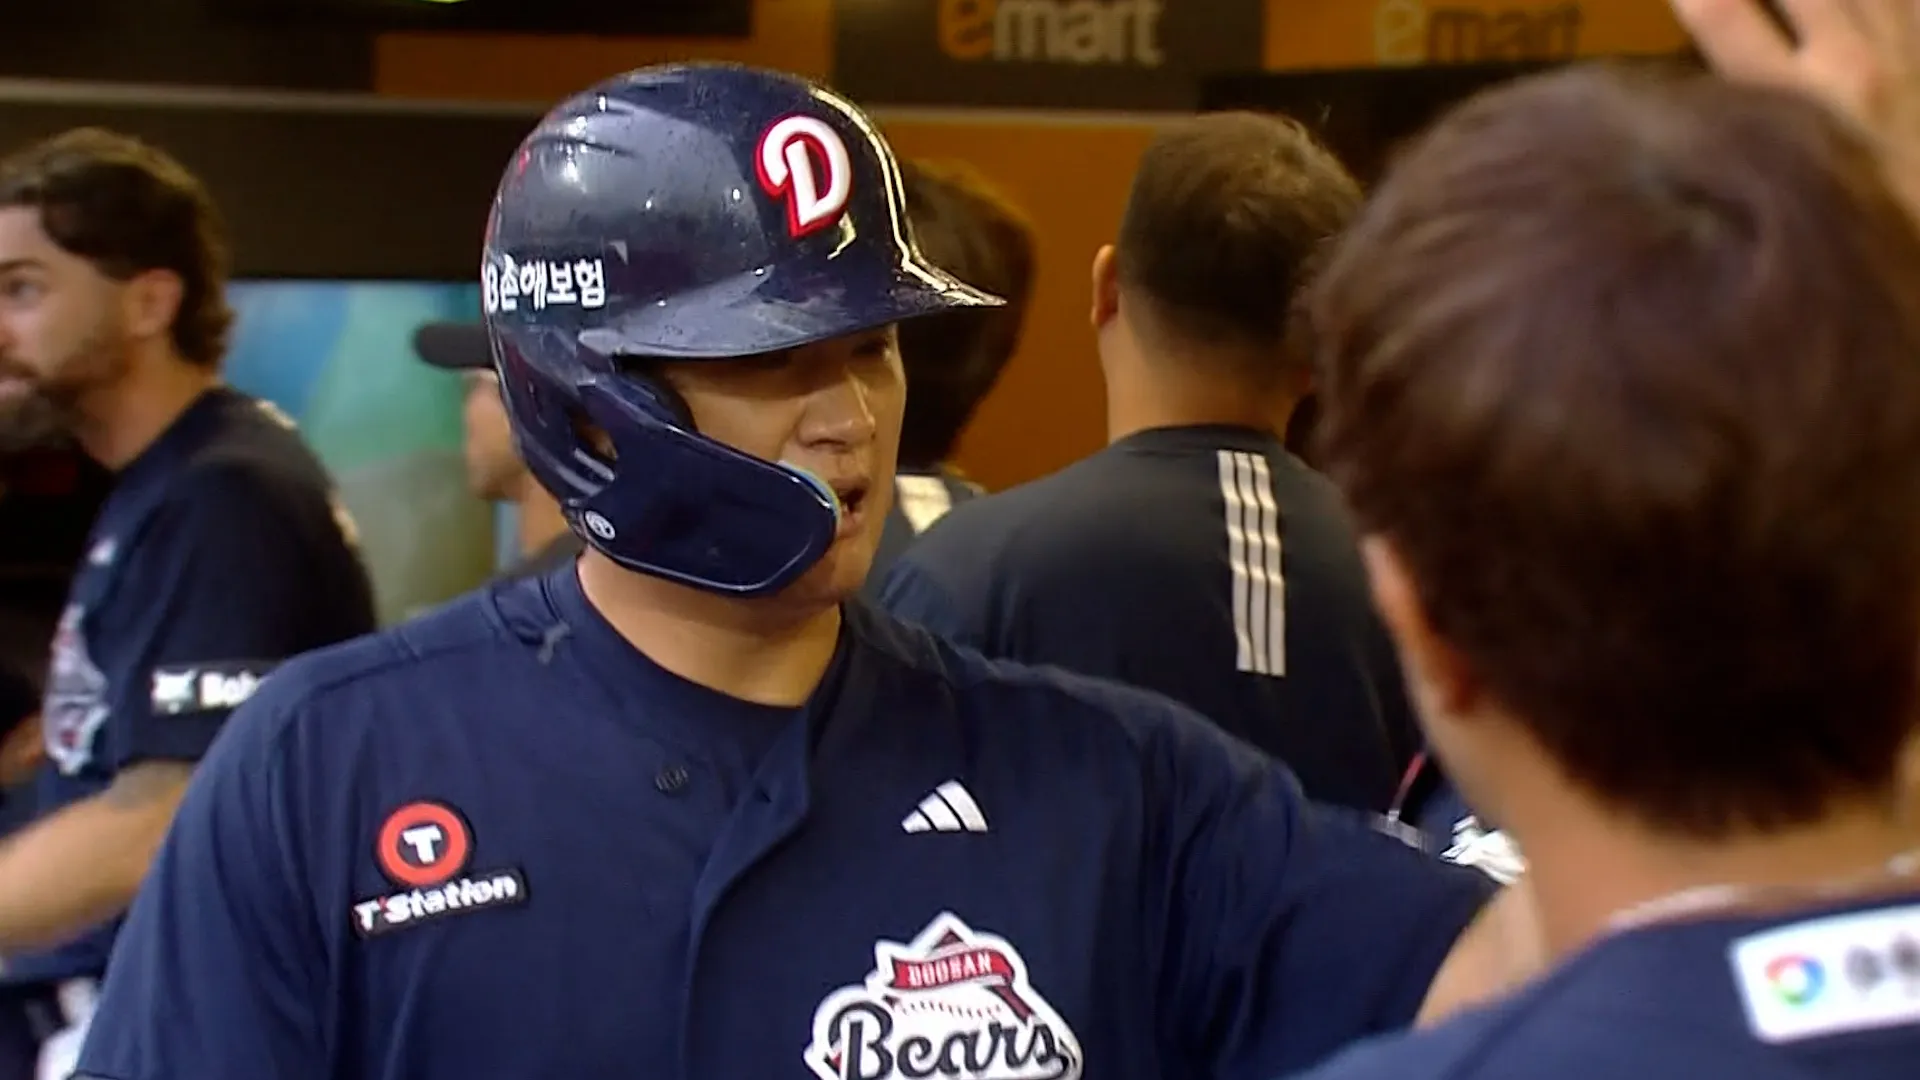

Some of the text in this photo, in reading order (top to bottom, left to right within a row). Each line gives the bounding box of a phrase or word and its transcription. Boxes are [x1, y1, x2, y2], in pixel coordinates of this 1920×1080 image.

[938, 0, 1166, 67] emart
[754, 113, 851, 238] D
[401, 825, 443, 865] T
[907, 950, 993, 987] DOOSAN
[828, 1000, 1070, 1080] Bears
